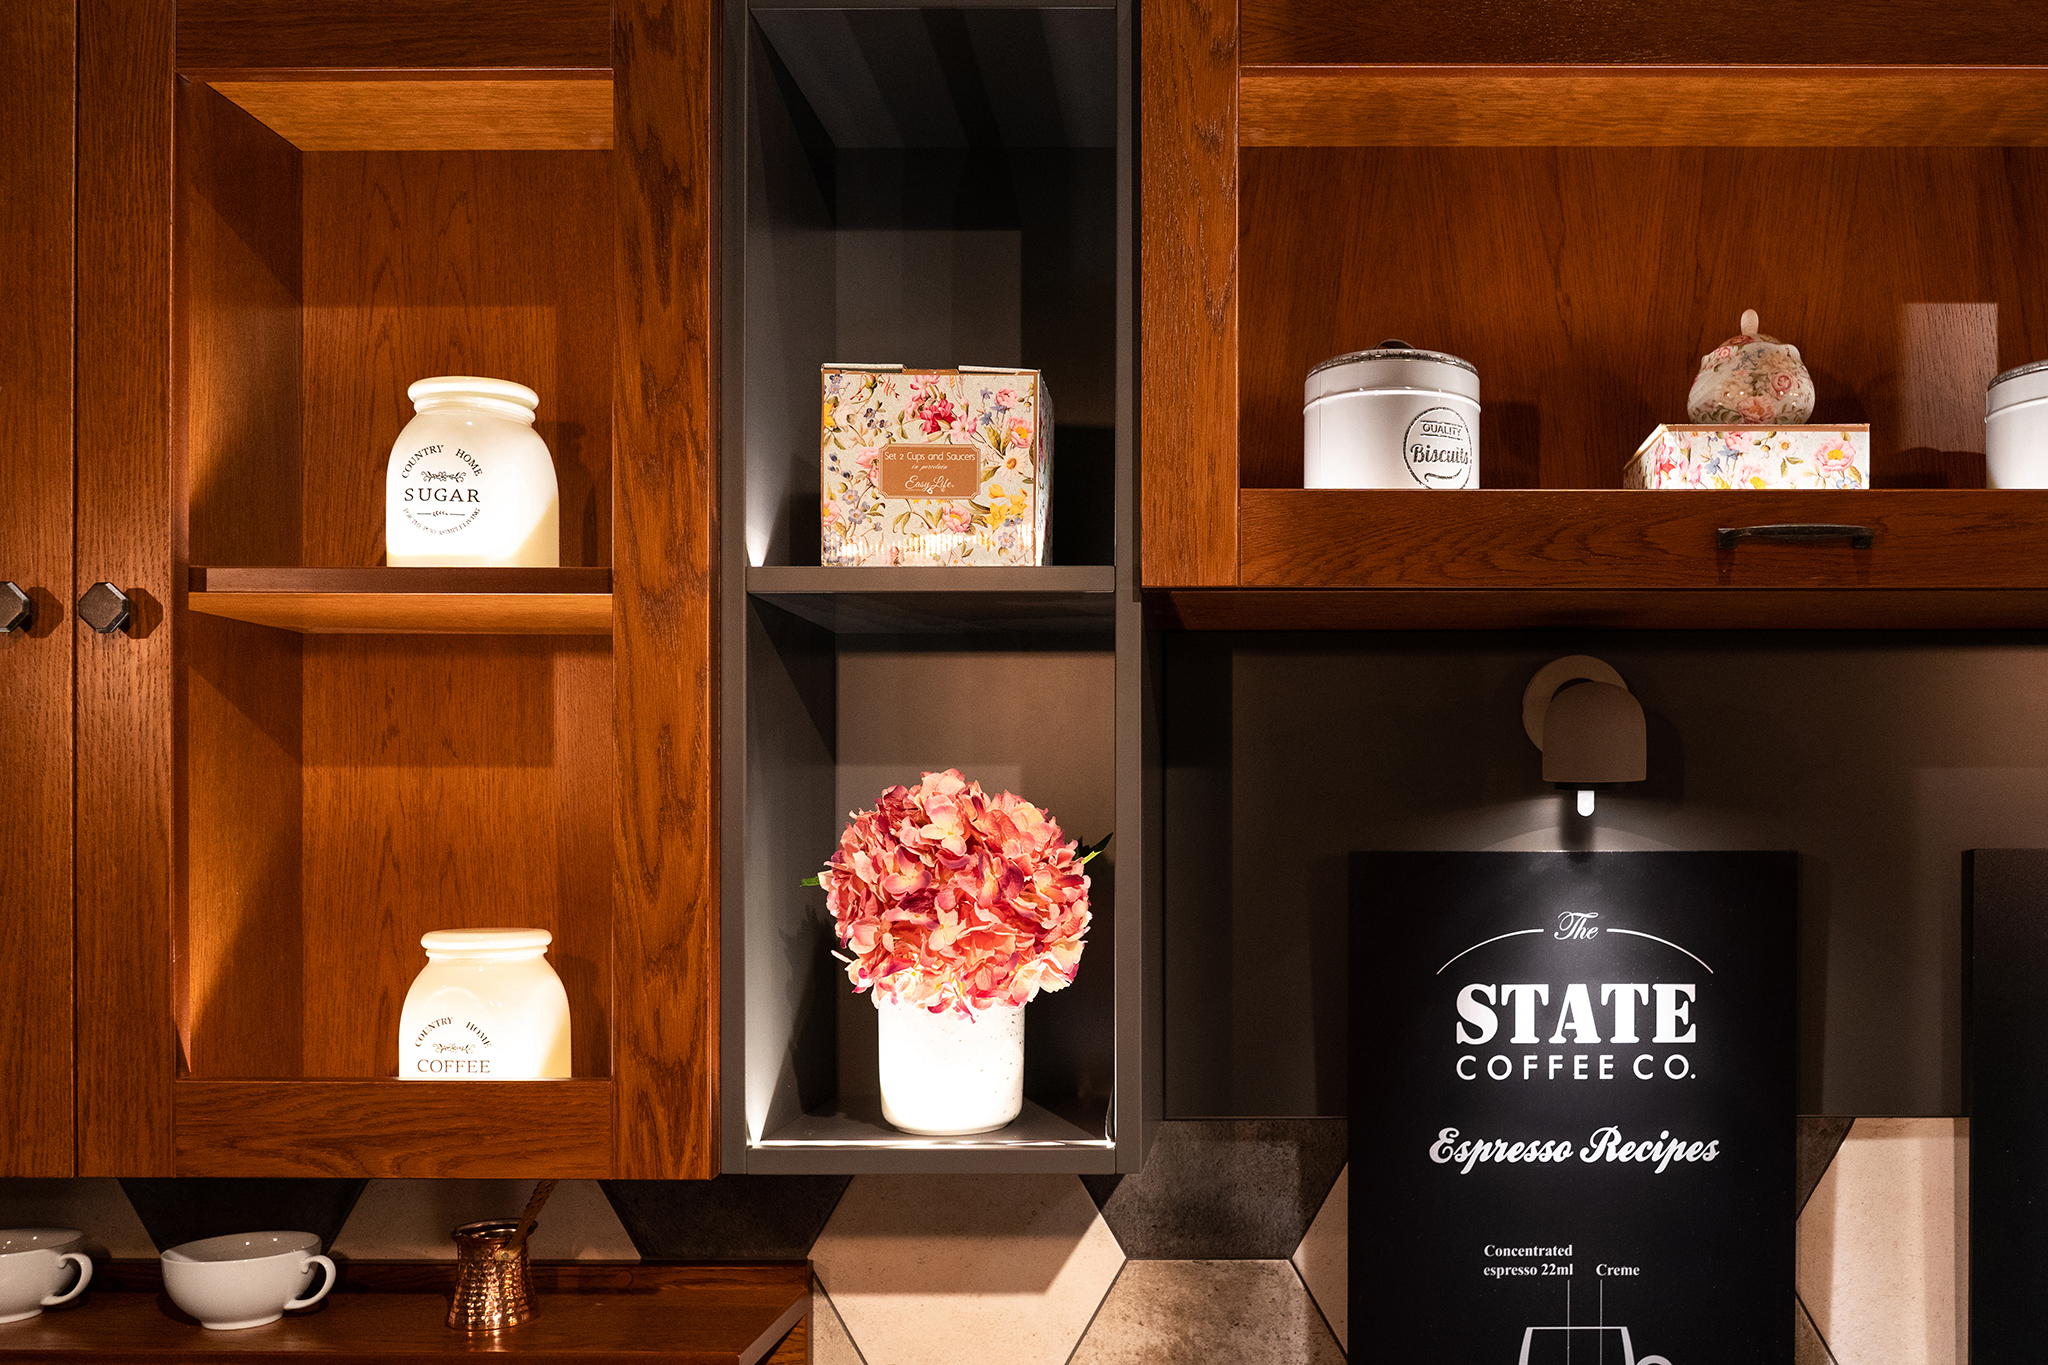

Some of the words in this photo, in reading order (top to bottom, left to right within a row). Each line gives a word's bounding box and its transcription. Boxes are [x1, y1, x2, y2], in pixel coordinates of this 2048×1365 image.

[1422, 423, 1462, 437] QUALITY
[401, 444, 444, 479] COUNTRY
[455, 448, 483, 477] HOME
[884, 451, 897, 460] Set
[899, 453, 905, 461] 2
[906, 451, 926, 463] Cups
[927, 451, 944, 461] and
[946, 451, 975, 461] Saucers
[1410, 443, 1469, 465] Biscuits
[905, 475, 930, 492] Easy
[404, 487, 481, 503] SUGAR
[1553, 910, 1600, 941] The
[1455, 982, 1697, 1046] STATE
[414, 1016, 454, 1048] COUNTRY
[465, 1021, 492, 1049] HOME
[417, 1058, 491, 1074] COFFEE
[1455, 1053, 1615, 1081] COFFEE
[1632, 1053, 1697, 1081] CO.
[1428, 1127, 1574, 1176] Espresso
[1579, 1125, 1721, 1175] Recipes
[1483, 1244, 1574, 1258] Concentrated
[1483, 1265, 1538, 1280] espresso
[1540, 1263, 1574, 1277] 22ml
[1595, 1263, 1641, 1277] Creme
